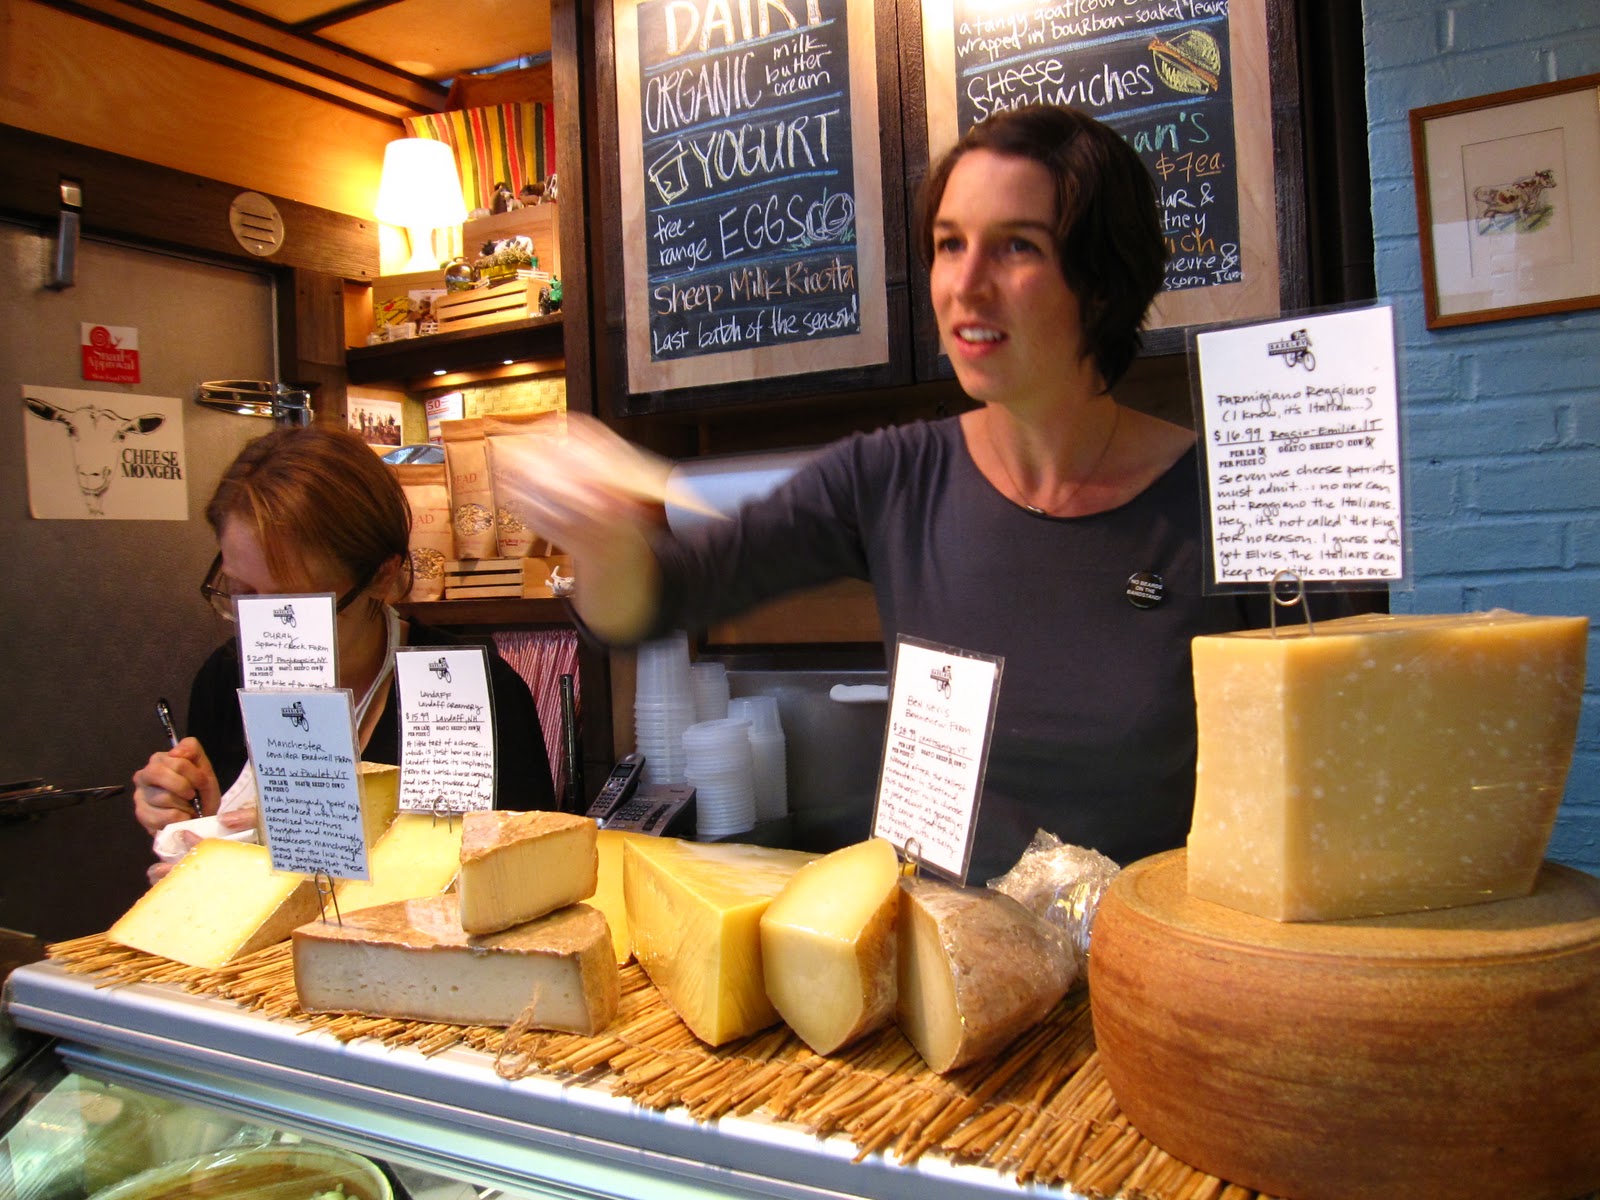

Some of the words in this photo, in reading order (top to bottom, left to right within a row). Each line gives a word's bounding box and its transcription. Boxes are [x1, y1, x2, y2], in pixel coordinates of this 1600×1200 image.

[960, 23, 972, 35] a
[972, 13, 1028, 37] tangy
[773, 34, 827, 60] milk
[958, 38, 1021, 62] wrapped
[1028, 28, 1044, 44] in
[766, 51, 832, 85] butter
[646, 52, 762, 133] ORGANIC
[774, 71, 830, 96] cream
[689, 109, 840, 188] YOGURT
[1200, 182, 1214, 207] &
[719, 195, 805, 259] EGGS
[660, 238, 712, 271] range
[1220, 243, 1239, 270] &
[654, 283, 724, 315] Sheep
[730, 267, 782, 301] Milk
[785, 257, 855, 296] Ricotta
[653, 330, 689, 354] Last
[699, 315, 741, 347] batch
[746, 310, 765, 342] of
[769, 307, 799, 336] the
[428, 400, 441, 410] 50
[1306, 385, 1376, 404] Reggiano
[122, 448, 179, 466] CHEESE
[122, 462, 183, 480] MONGER
[1270, 470, 1290, 478] we
[1297, 465, 1343, 475] cheese
[1218, 486, 1253, 497] must
[1365, 481, 1391, 493] can
[1312, 497, 1335, 509] the
[1280, 517, 1305, 527] not
[1307, 514, 1341, 527] called
[1333, 536, 1368, 550] guess
[1220, 549, 1241, 566] got
[1289, 549, 1313, 560] the
[1320, 550, 1369, 561] Italians
[1373, 552, 1396, 561] can
[1222, 567, 1253, 581] keep
[1319, 568, 1335, 576] on
[1339, 567, 1363, 576] this
